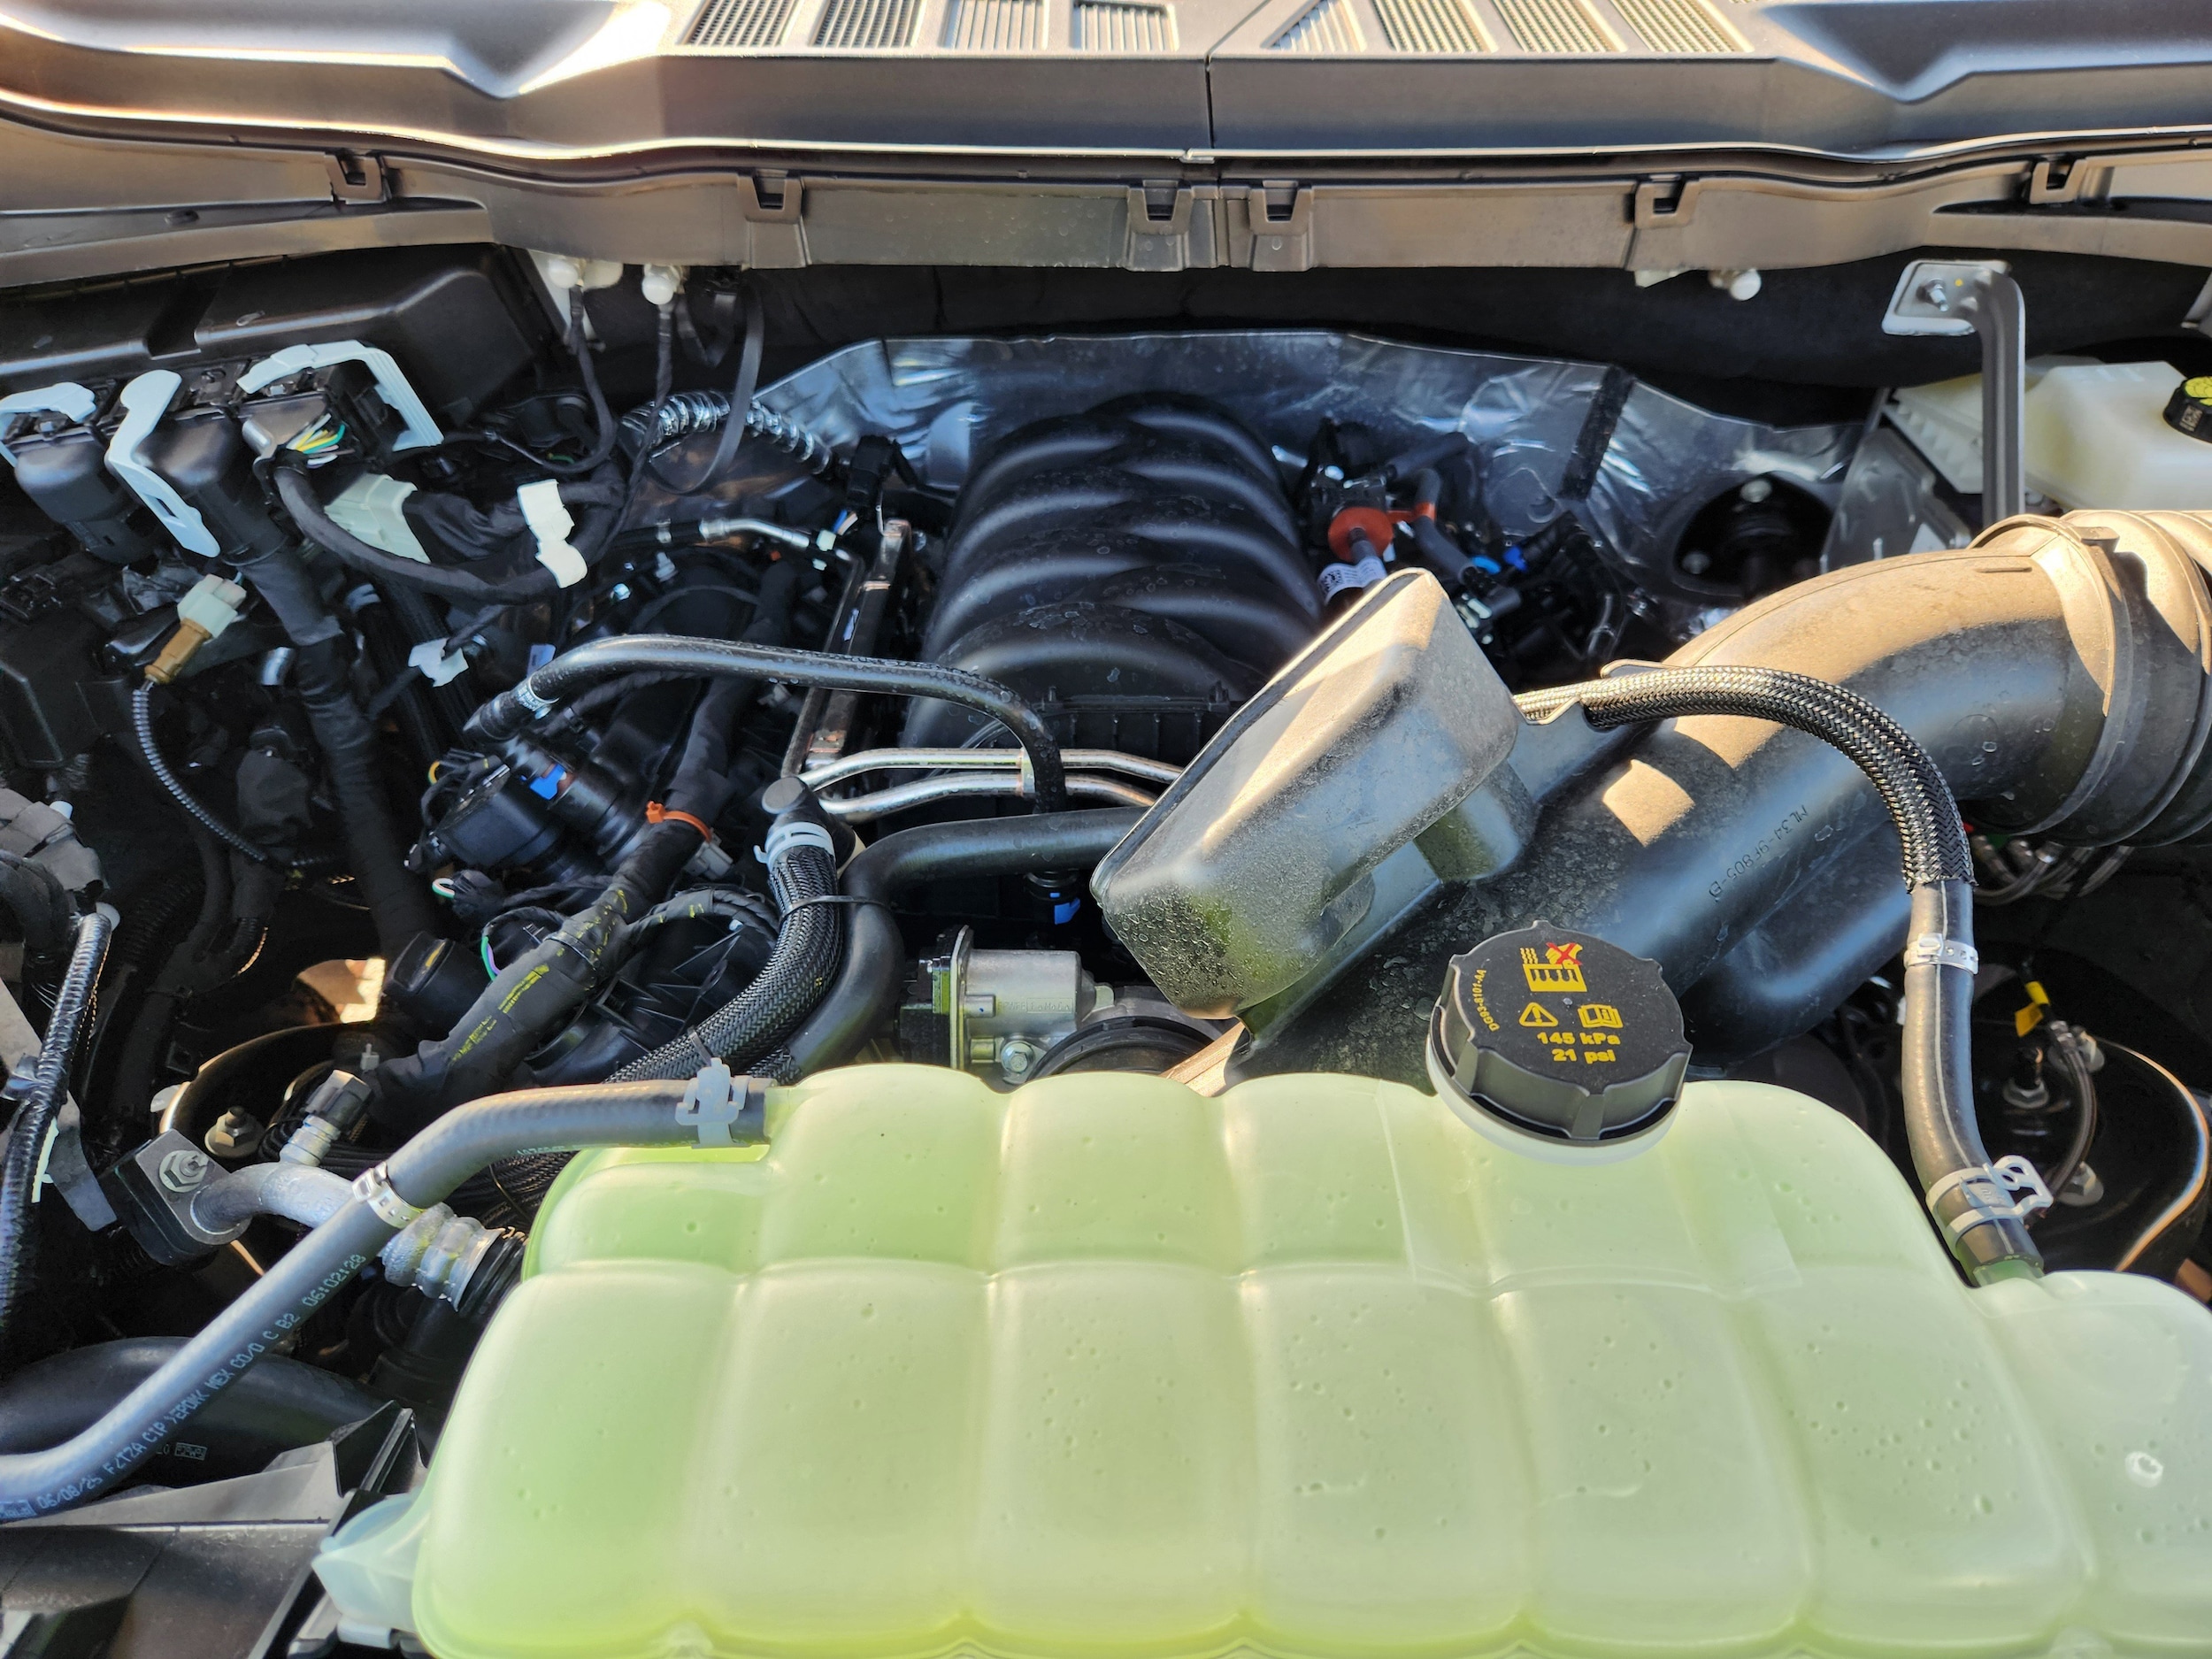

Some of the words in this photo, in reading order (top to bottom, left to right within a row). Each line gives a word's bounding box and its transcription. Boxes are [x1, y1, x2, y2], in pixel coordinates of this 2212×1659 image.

[1471, 969, 1500, 1032] DG93-8101-AA
[1537, 1032, 1576, 1046] 145
[1580, 1033, 1621, 1046] kPa
[1551, 1049, 1578, 1063] 21
[1585, 1049, 1617, 1065] psi
[263, 1330, 279, 1340] C
[302, 1254, 366, 1307] 06:02:28
